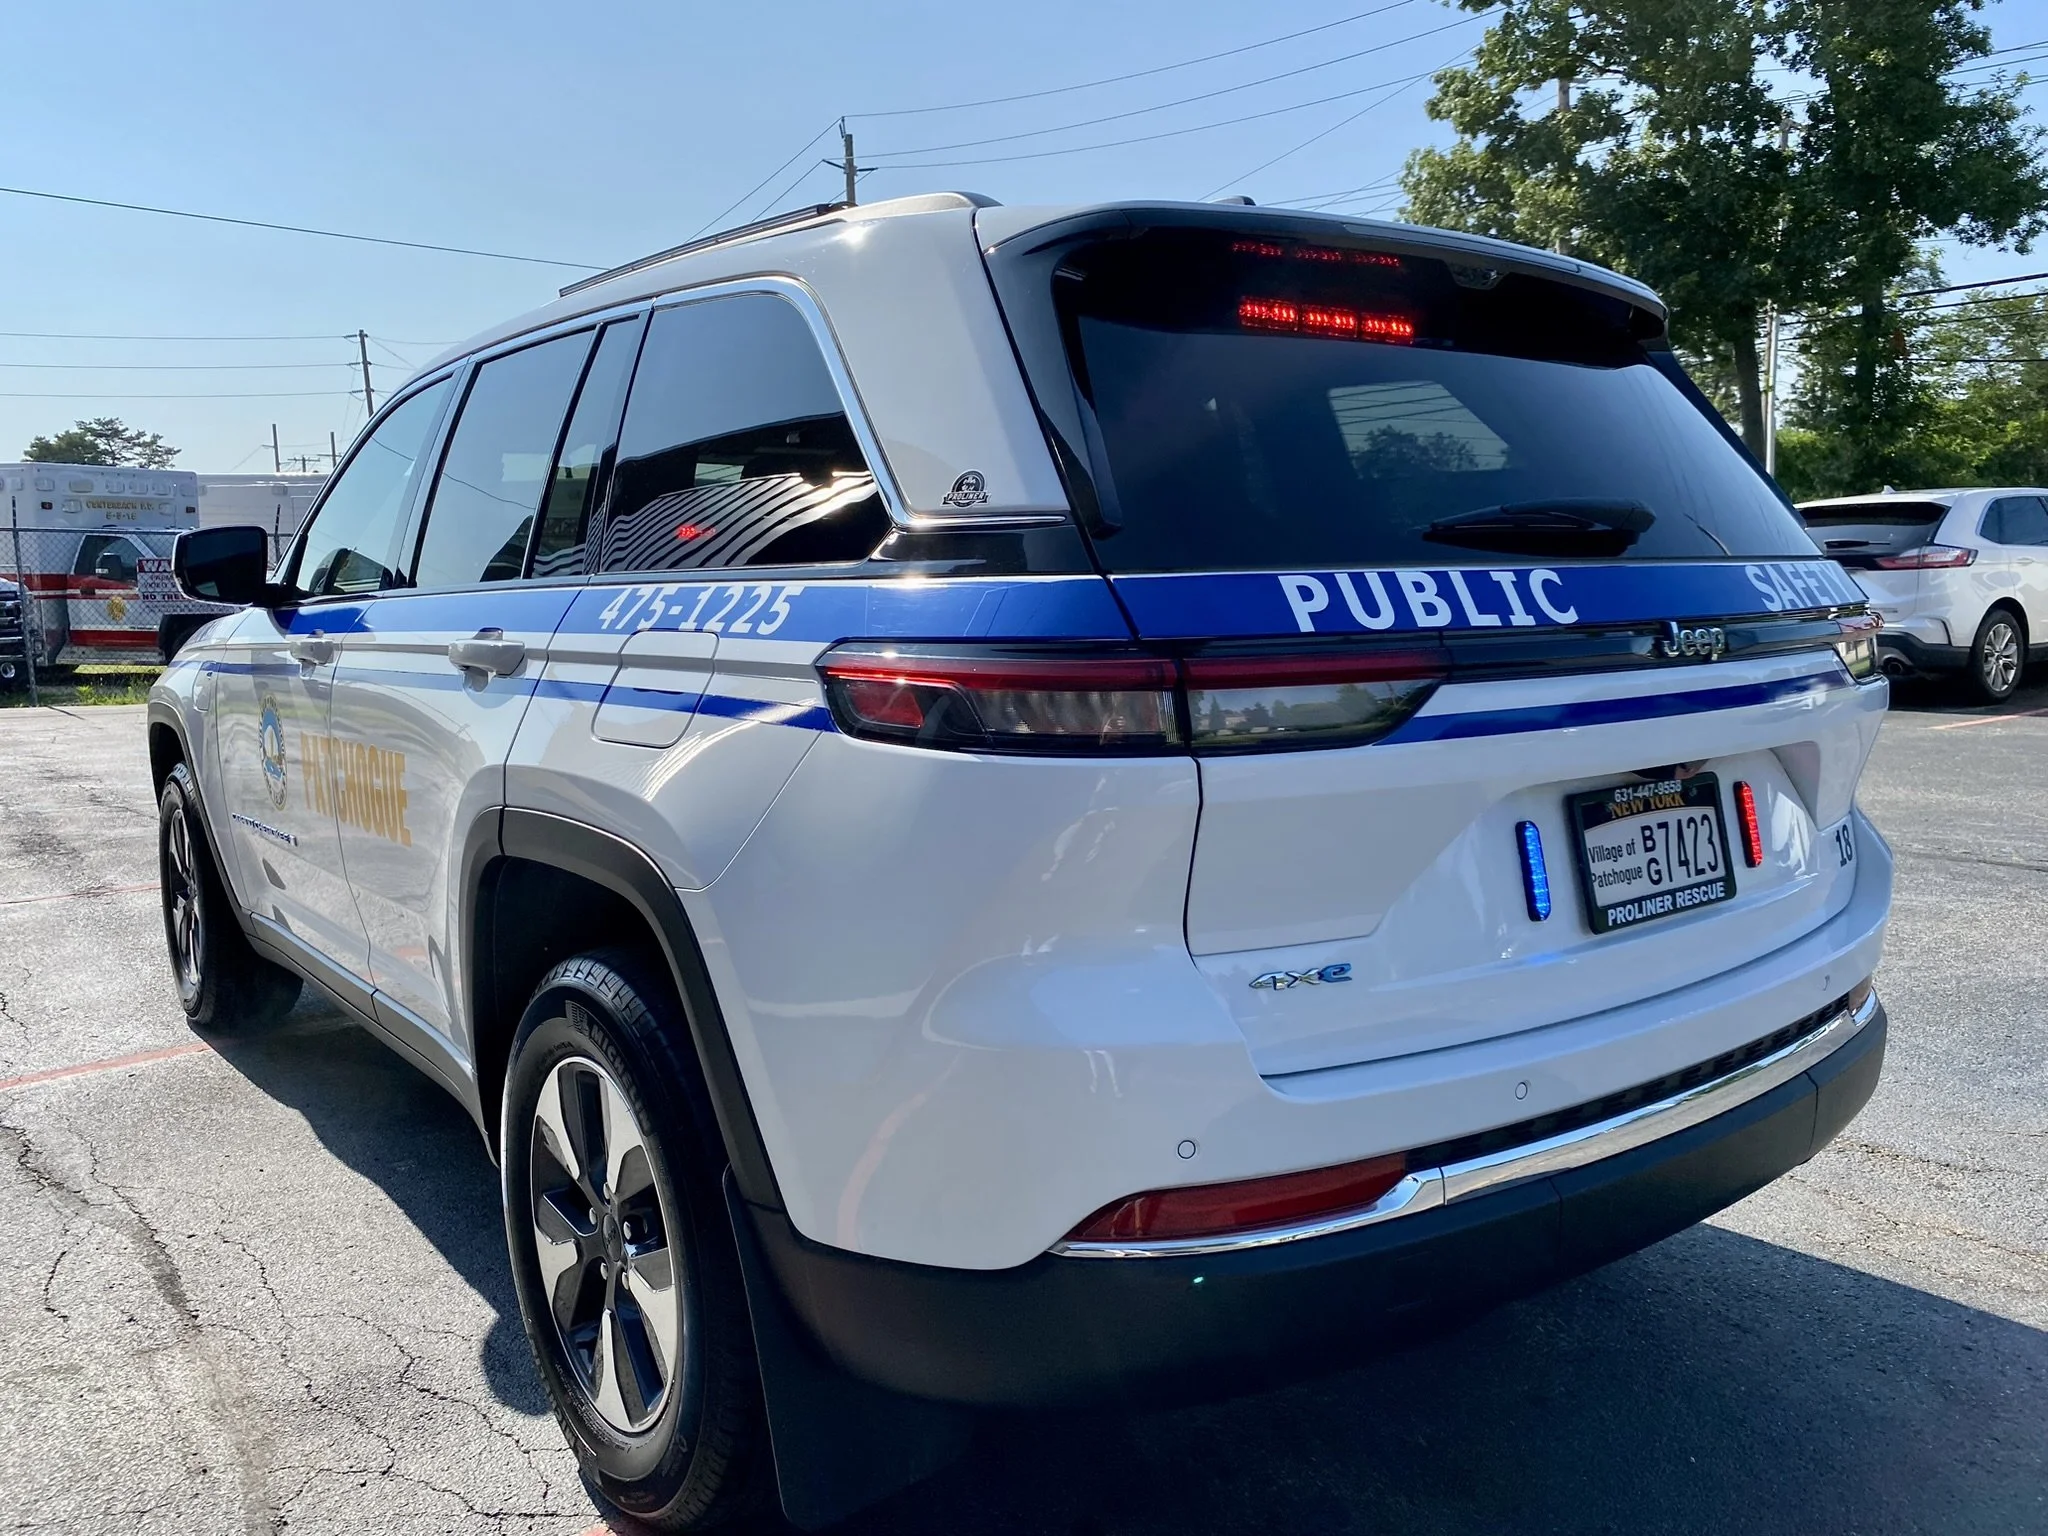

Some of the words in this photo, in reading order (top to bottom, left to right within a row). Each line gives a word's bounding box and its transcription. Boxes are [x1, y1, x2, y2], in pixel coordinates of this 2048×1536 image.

[598, 585, 804, 636] 475-1225
[1278, 568, 1579, 632] PUBLIC
[1744, 562, 1855, 612] SAFETY
[1662, 620, 1725, 662] Jeep
[300, 731, 412, 848] PATCHOGUE
[1610, 798, 1645, 819] NEW
[1648, 794, 1686, 809] YORK
[1614, 779, 1683, 803] 631-447-9558
[1588, 844, 1625, 864] Village
[1626, 838, 1637, 856] of
[1656, 813, 1719, 883] 7423
[1835, 823, 1853, 868] 18
[1592, 865, 1644, 888] Patchogue
[1607, 899, 1674, 927] PROLINER
[1676, 882, 1726, 909] RESCUE
[590, 1024, 652, 1138] MICHELIN
